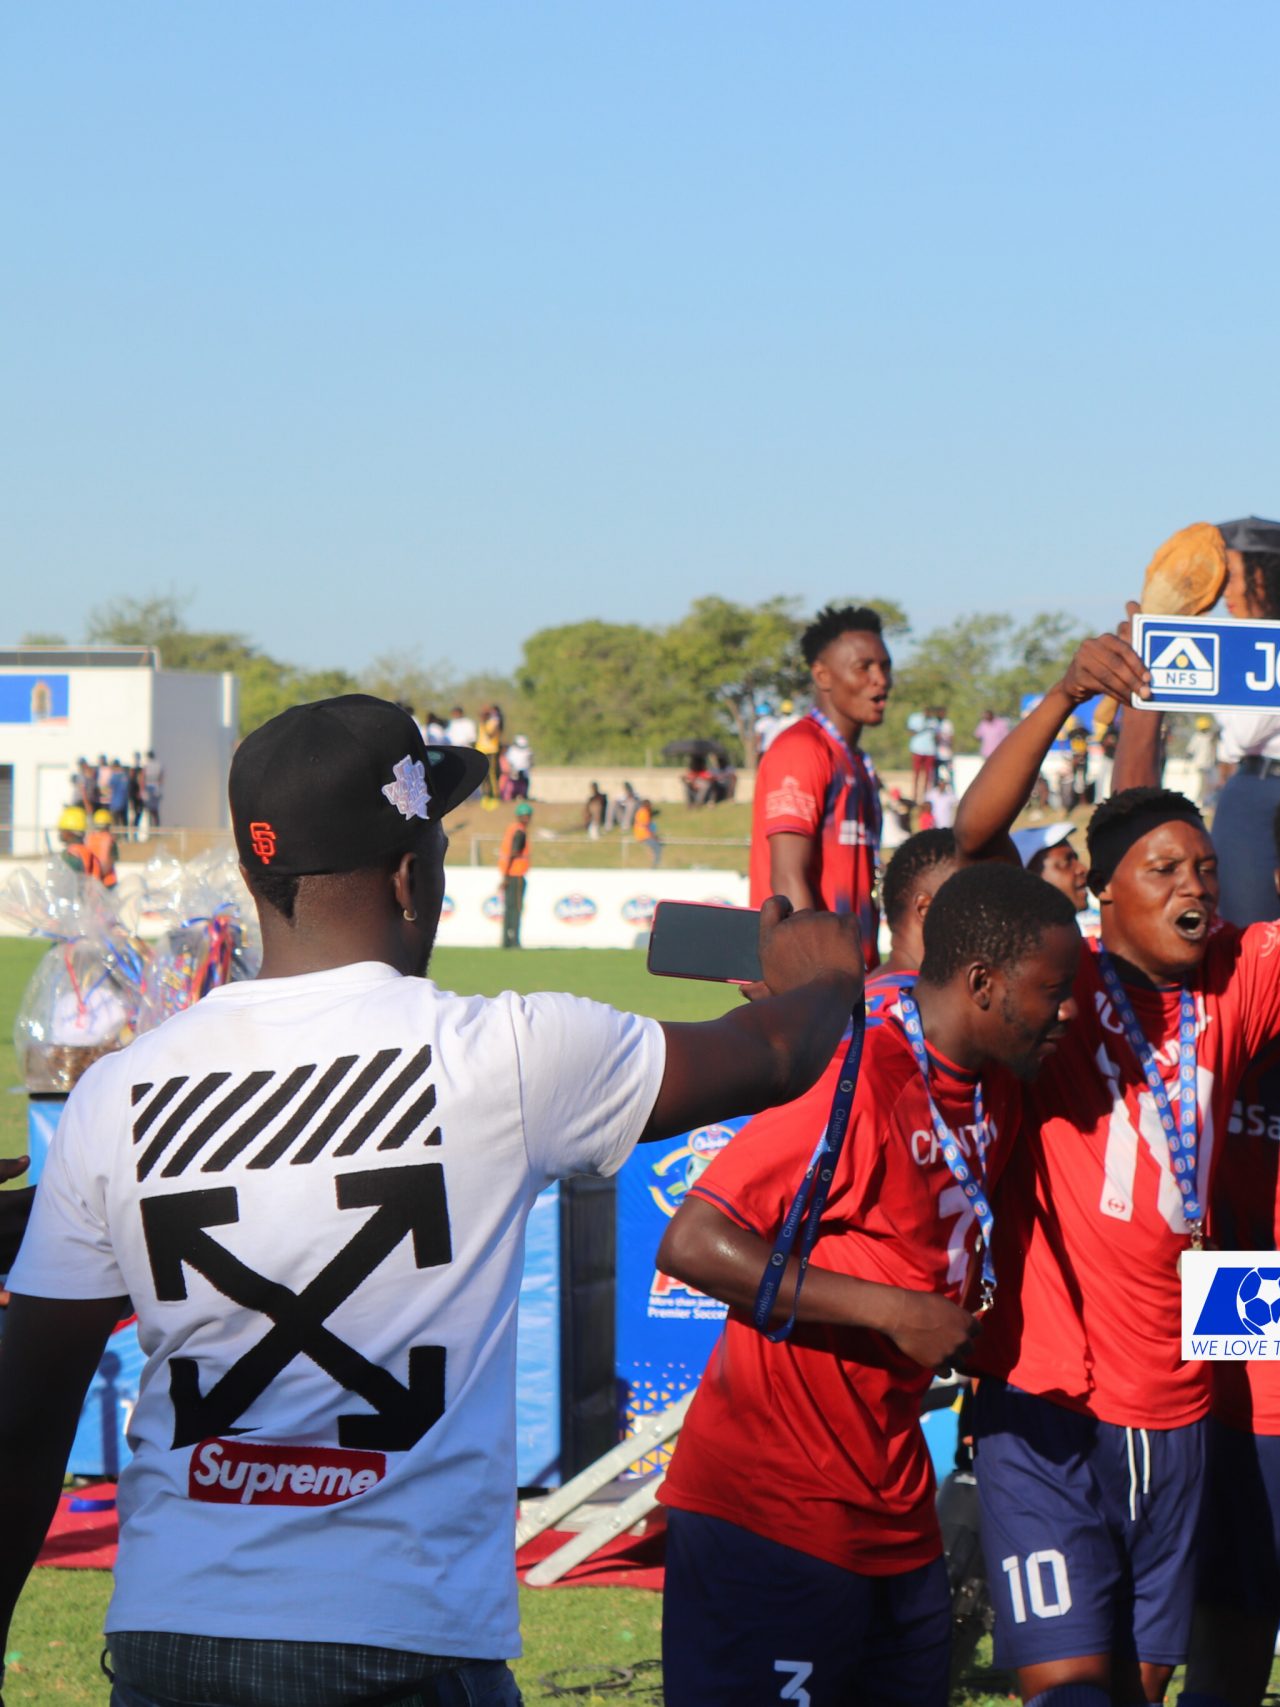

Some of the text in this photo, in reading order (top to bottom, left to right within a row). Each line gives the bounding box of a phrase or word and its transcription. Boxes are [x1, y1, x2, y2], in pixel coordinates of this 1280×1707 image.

[1165, 672, 1198, 686] NFS
[648, 1307, 692, 1319] Premier
[193, 1443, 378, 1505] Supreme
[1002, 1549, 1073, 1624] 10
